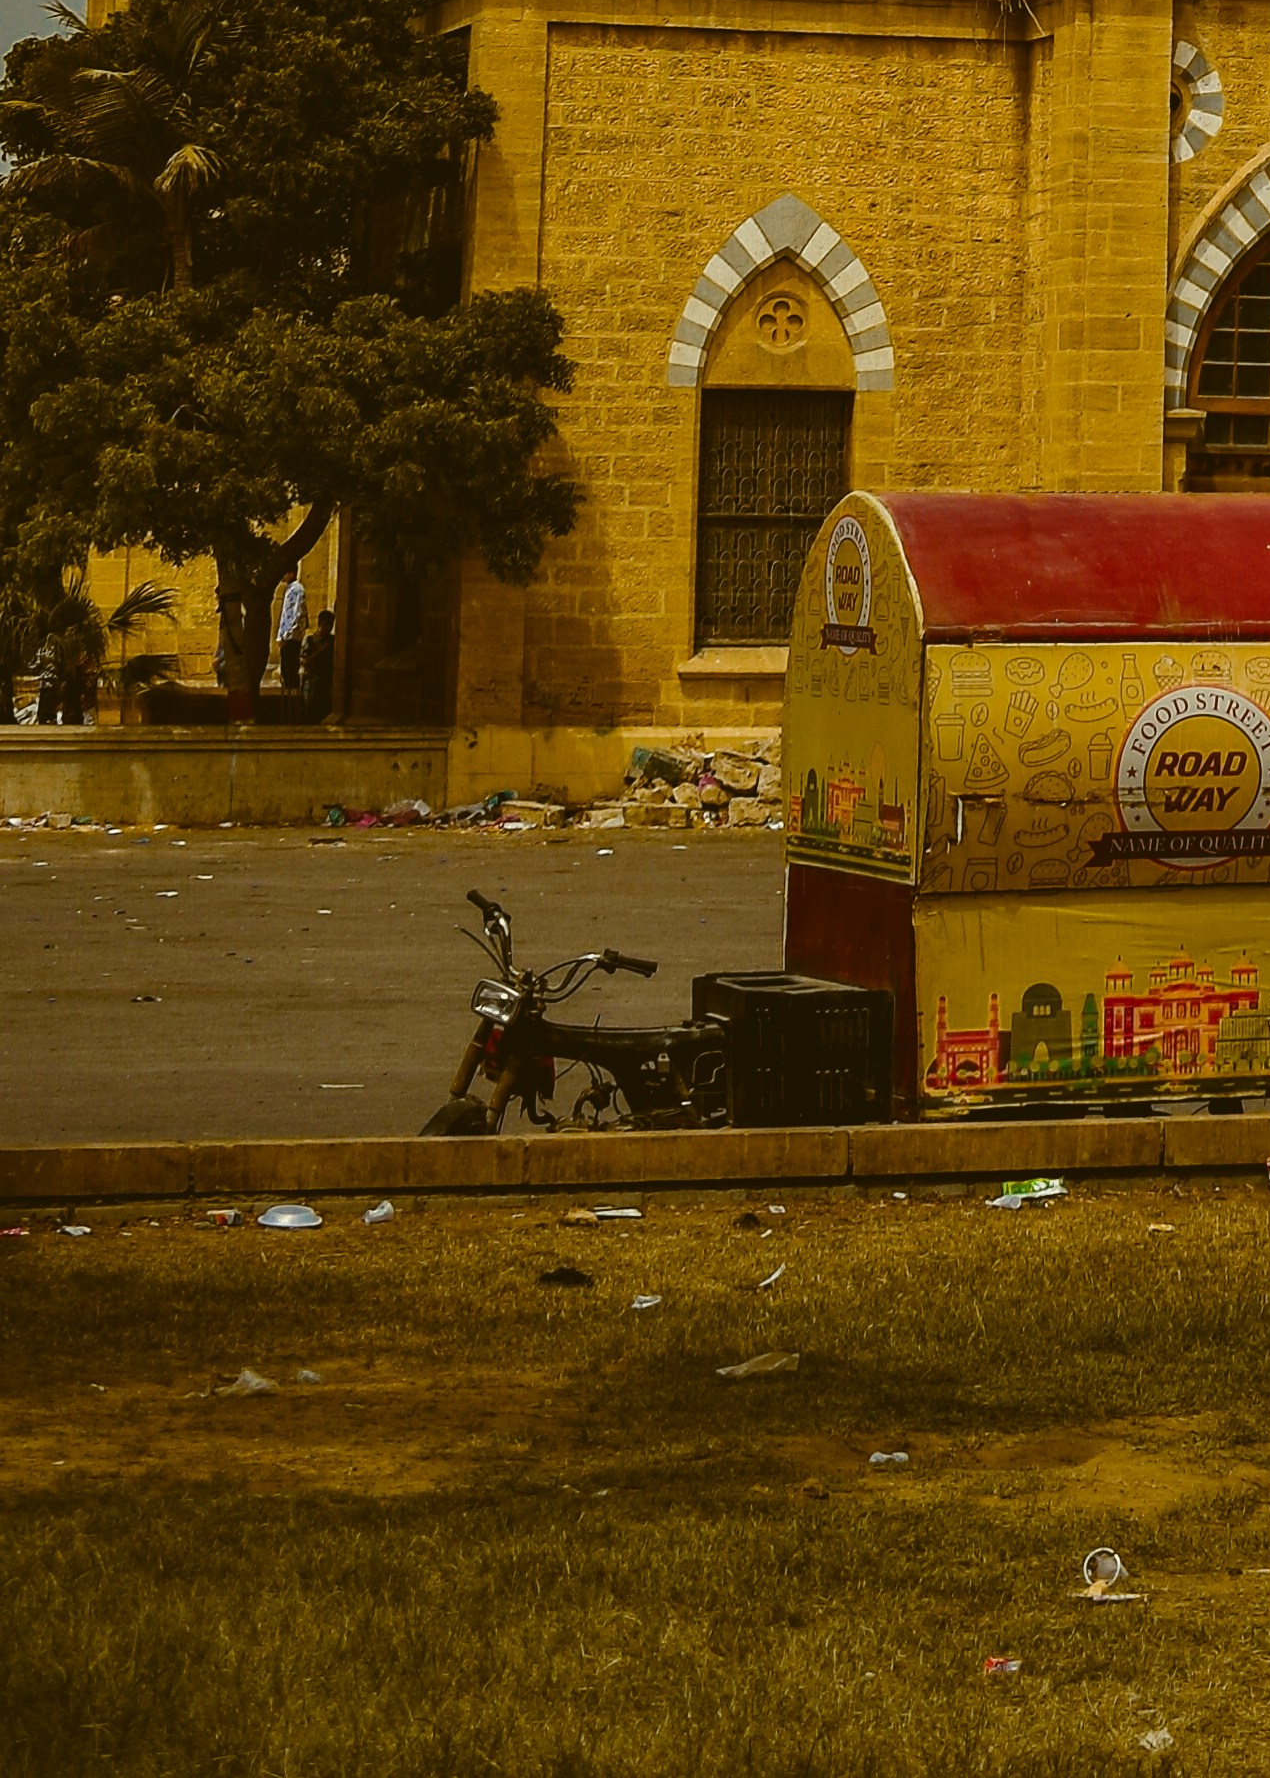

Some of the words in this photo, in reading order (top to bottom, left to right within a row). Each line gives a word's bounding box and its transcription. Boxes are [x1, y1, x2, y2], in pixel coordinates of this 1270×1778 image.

[835, 565, 860, 584] ROAD
[838, 591, 858, 611] WAY
[1131, 697, 1189, 757] FOOD
[1154, 751, 1248, 777] ROAD
[1163, 786, 1240, 813] WAY
[1110, 837, 1166, 853] NAME
[1170, 836, 1196, 852] OF
